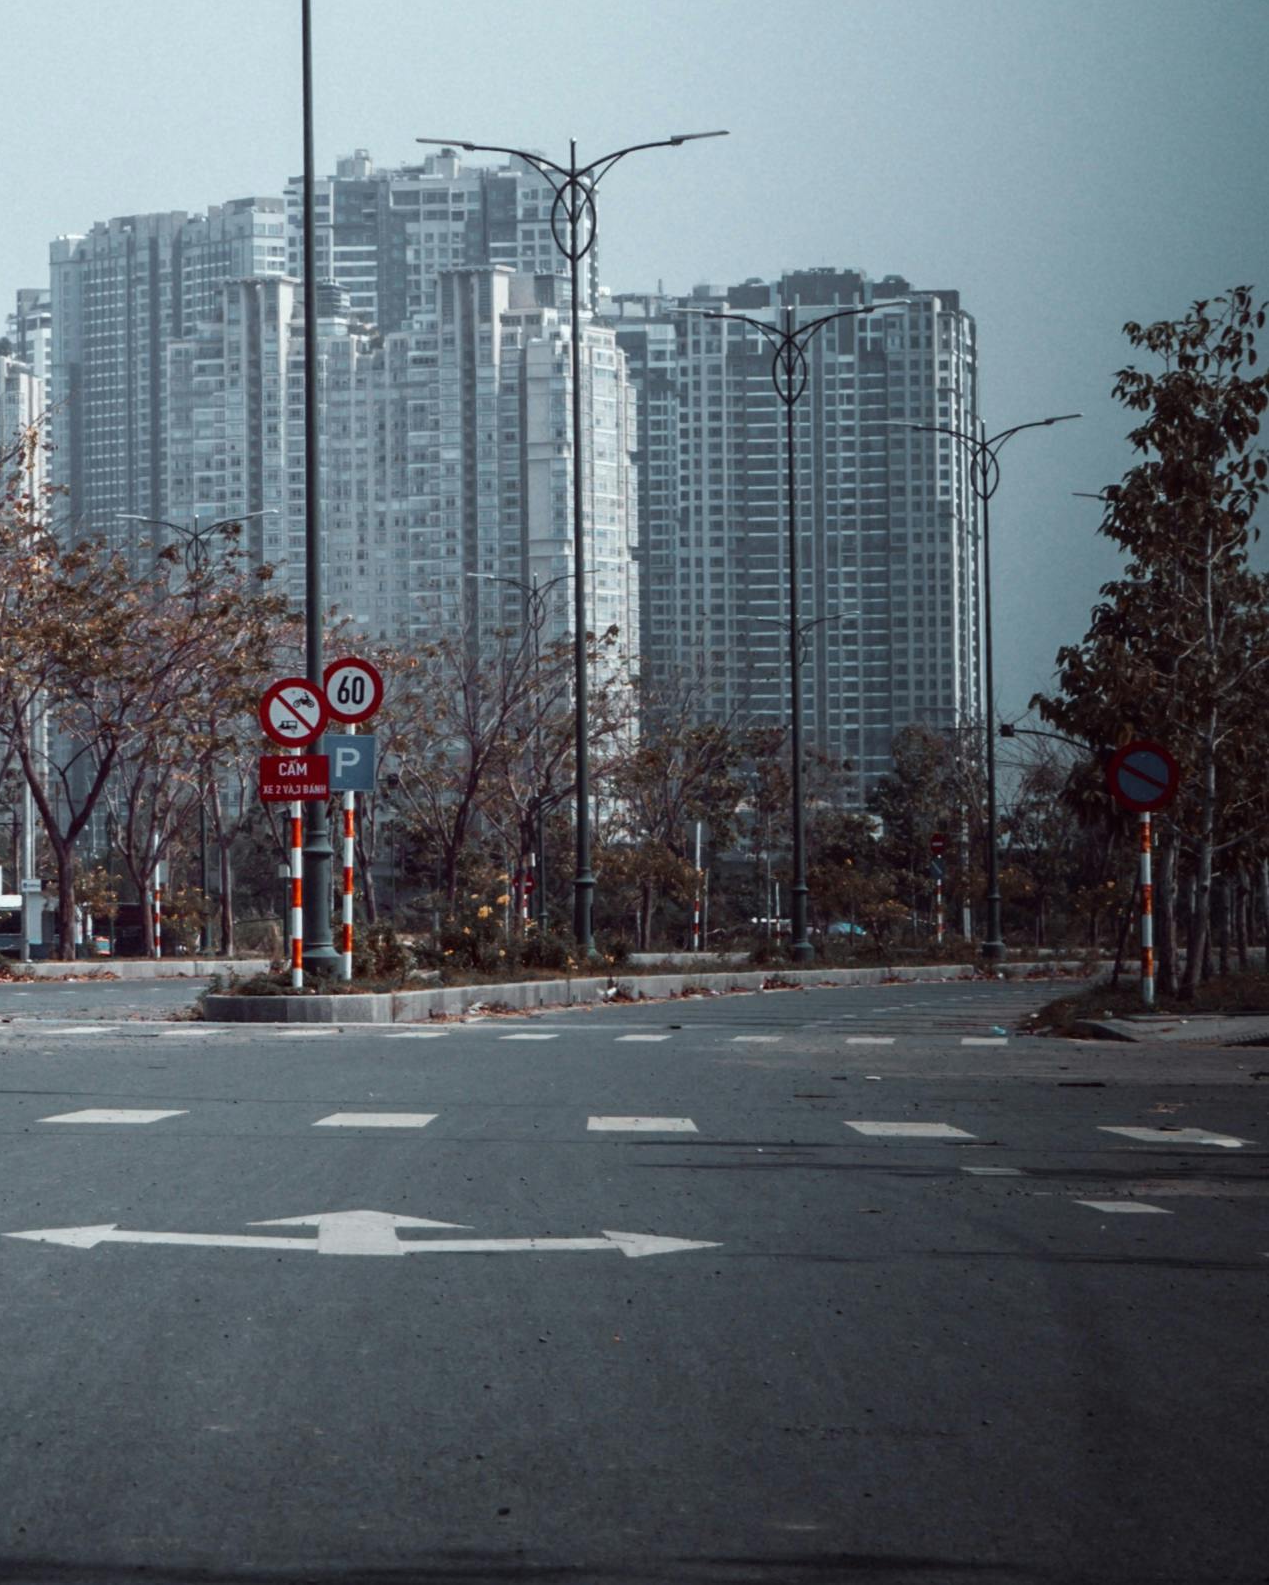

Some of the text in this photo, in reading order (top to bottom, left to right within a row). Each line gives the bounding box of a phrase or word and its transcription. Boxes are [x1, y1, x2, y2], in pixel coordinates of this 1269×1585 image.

[337, 675, 365, 705] 60
[335, 747, 360, 778] P
[262, 784, 274, 794] XE
[275, 784, 282, 794] 2
